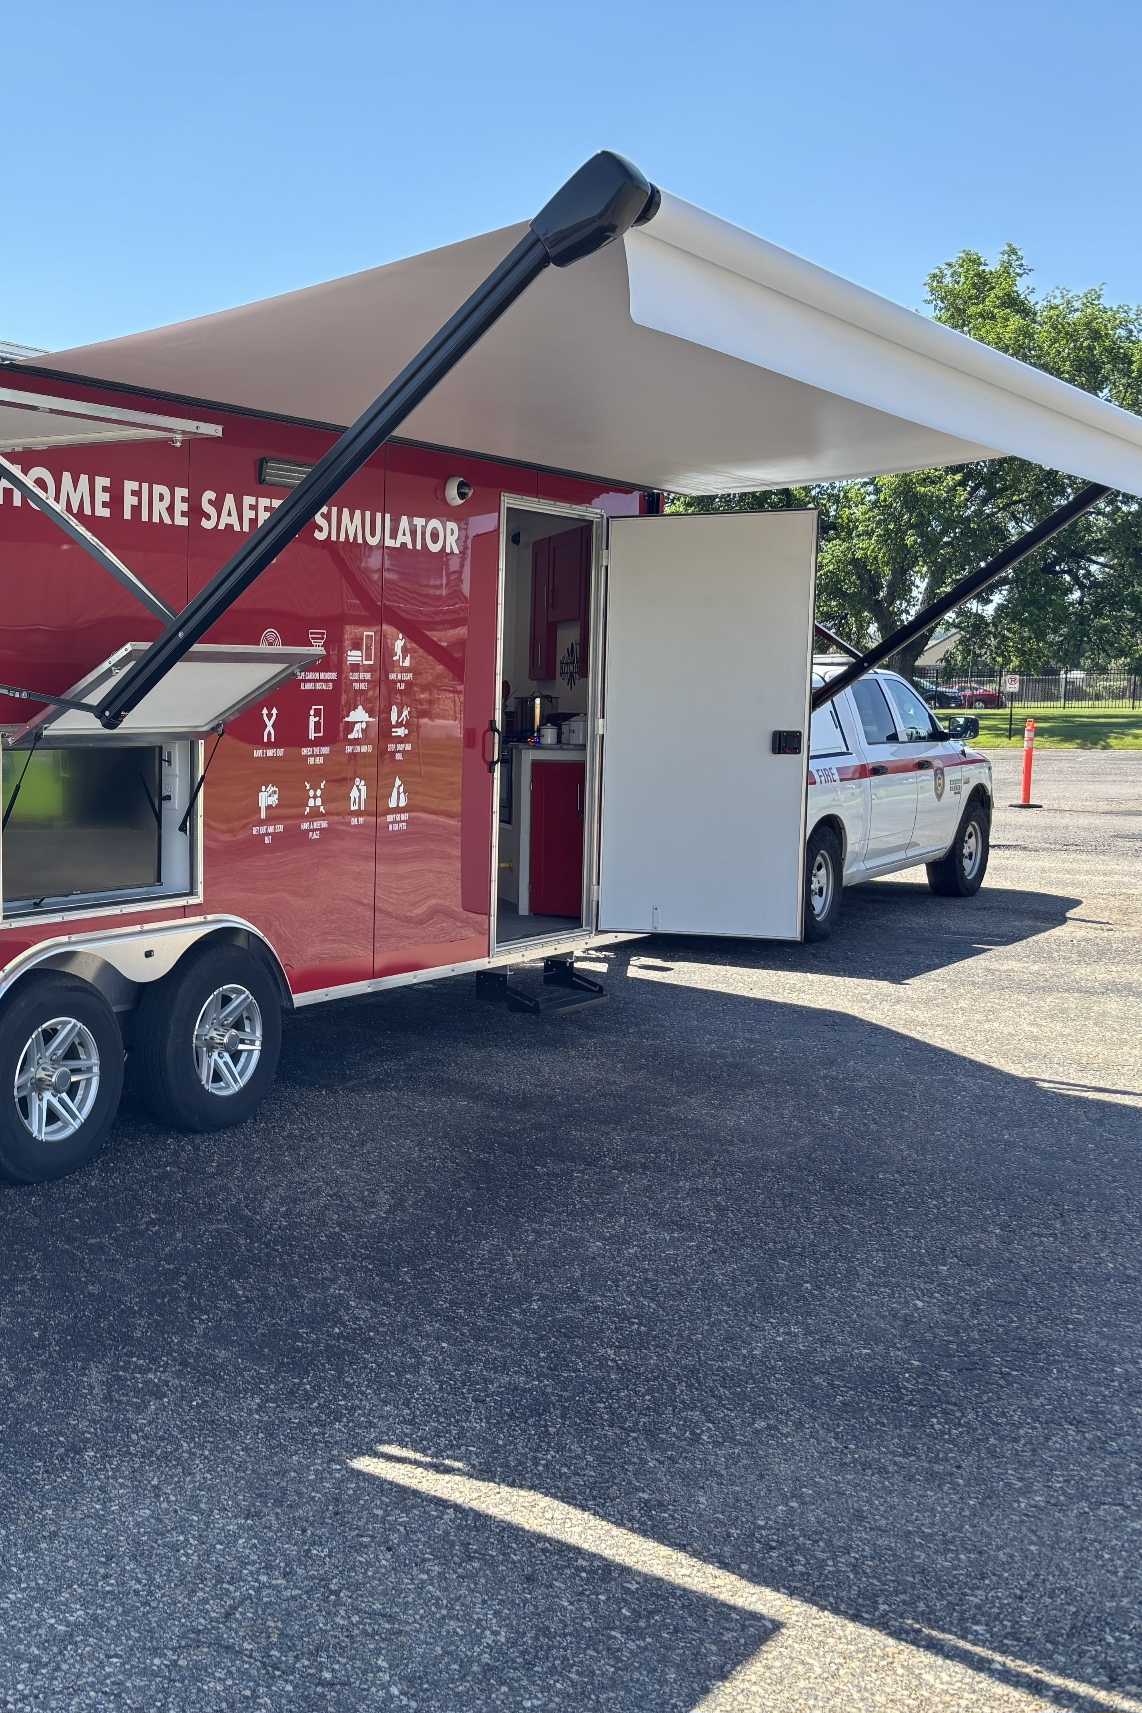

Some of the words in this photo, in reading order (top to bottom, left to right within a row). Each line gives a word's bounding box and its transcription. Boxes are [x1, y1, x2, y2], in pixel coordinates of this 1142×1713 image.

[123, 480, 189, 526] FIRE
[200, 490, 299, 538] SAFE
[313, 505, 460, 554] SIMULATOR
[816, 766, 836, 784] FIRE
[301, 822, 310, 830] HAVE
